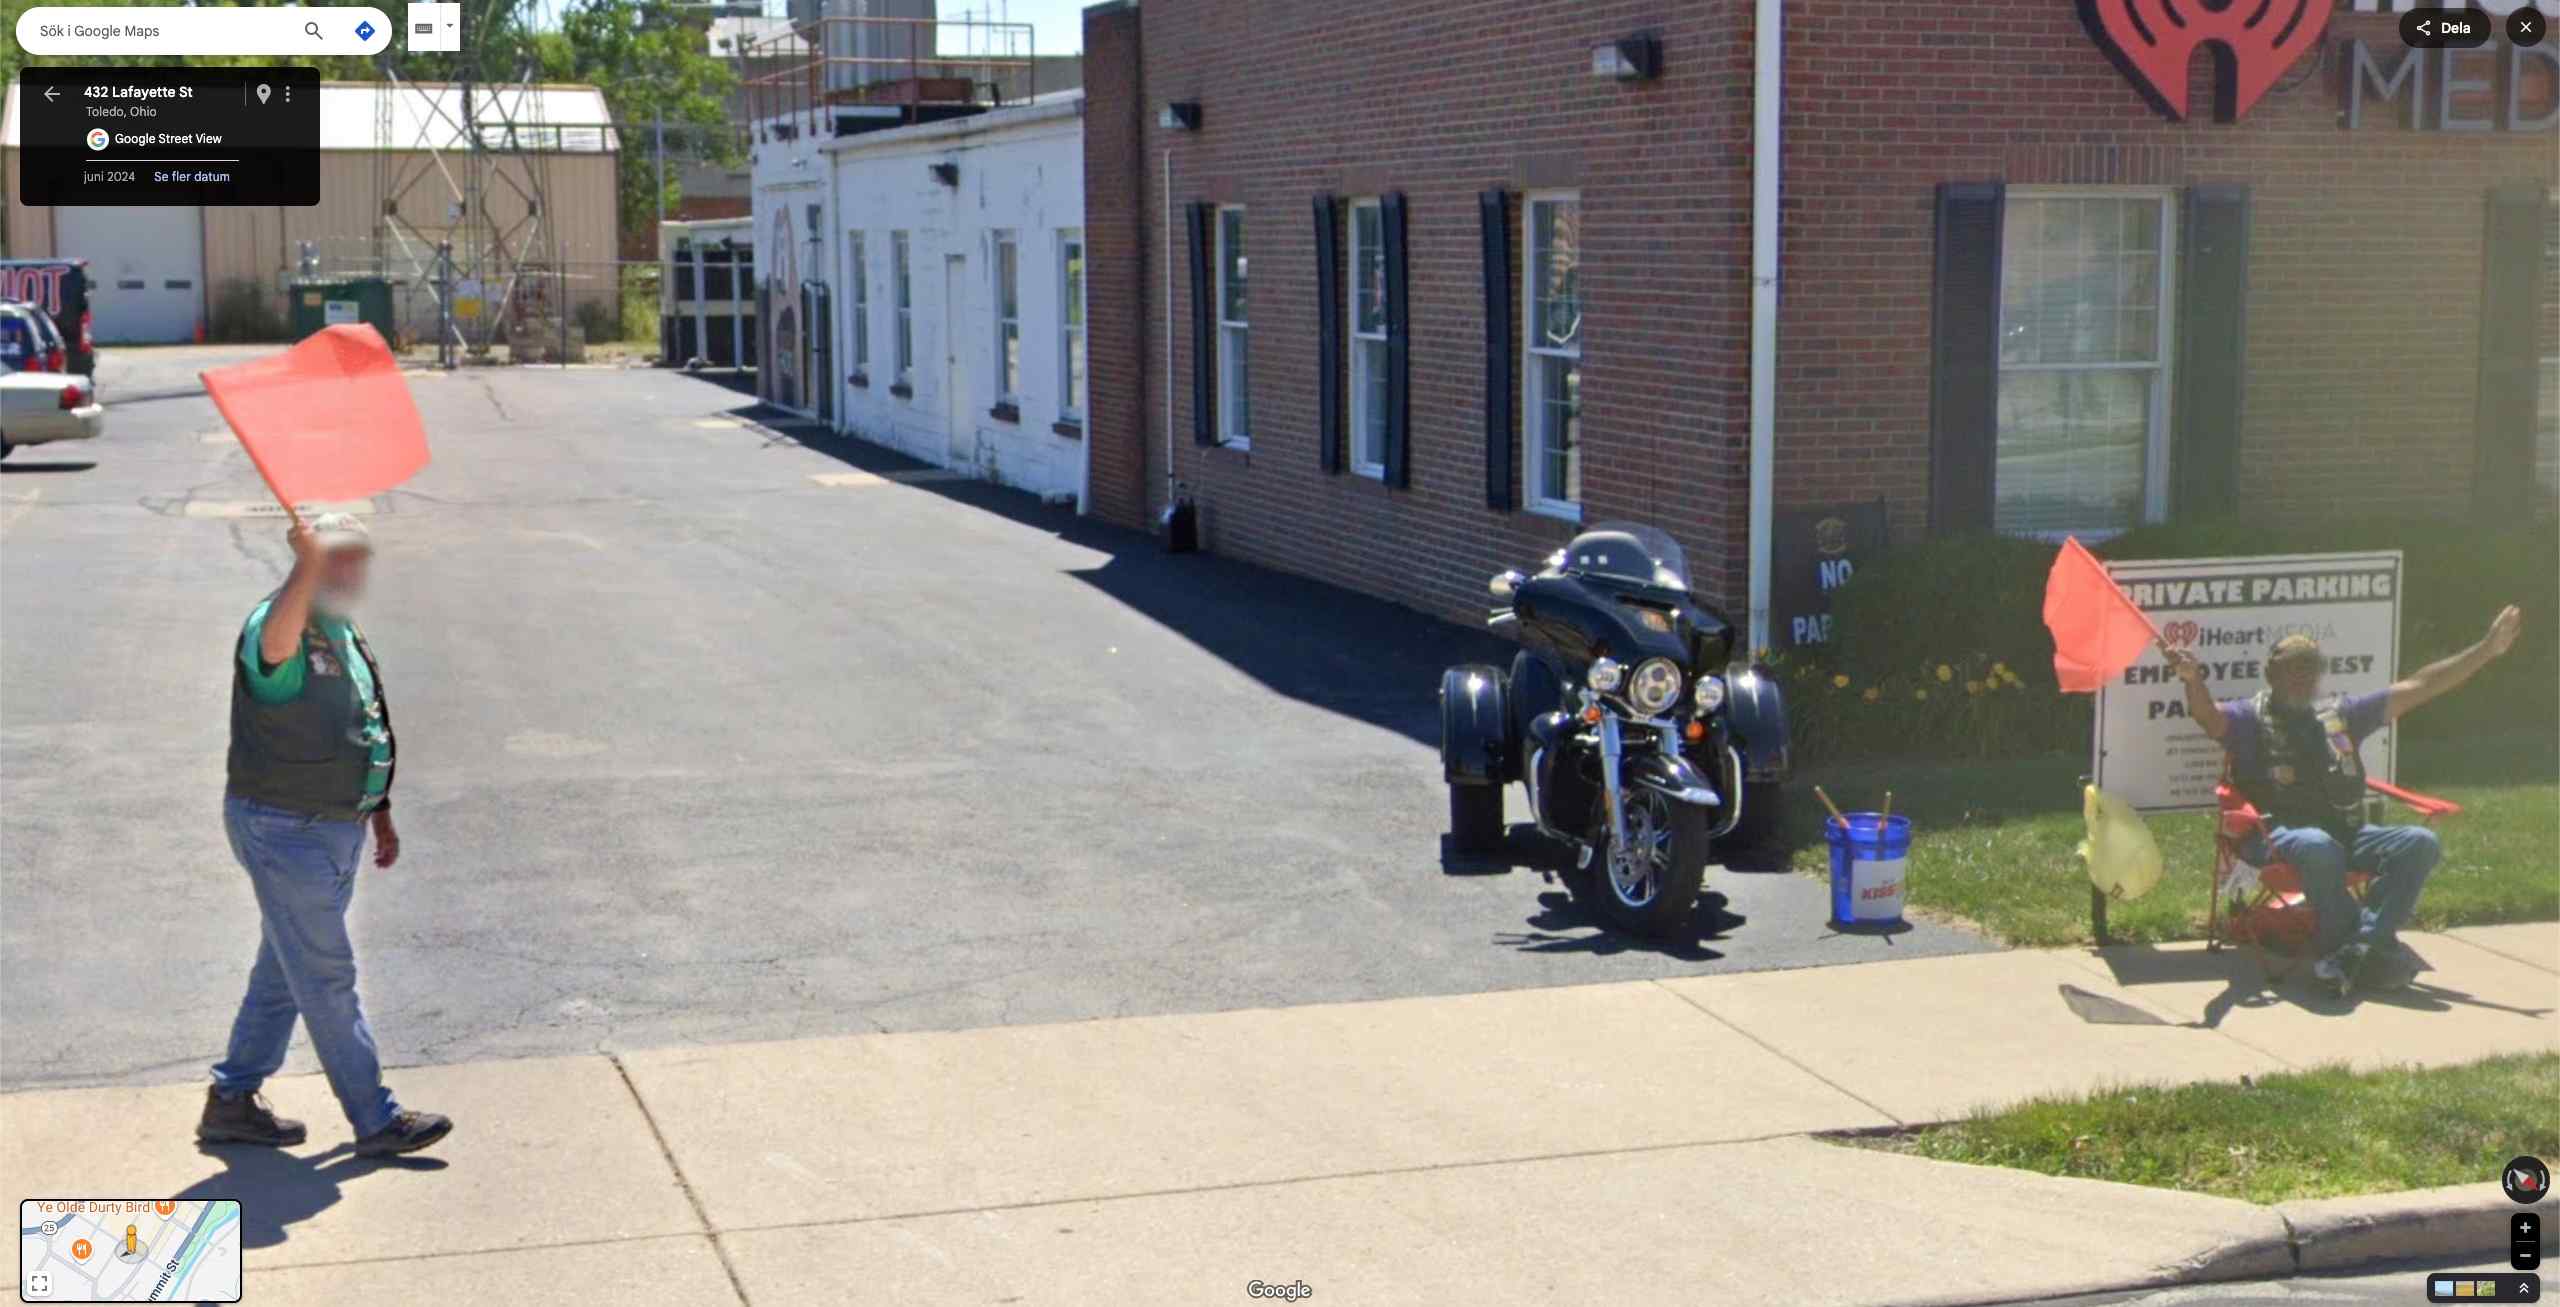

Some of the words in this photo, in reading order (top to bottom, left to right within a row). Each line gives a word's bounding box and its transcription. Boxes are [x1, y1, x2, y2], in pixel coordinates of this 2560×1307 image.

[1820, 558, 1853, 589] NO
[2118, 579, 2243, 607] PRIVATE
[2252, 574, 2391, 601] PARKING
[2124, 659, 2260, 685] EMPOYEE
